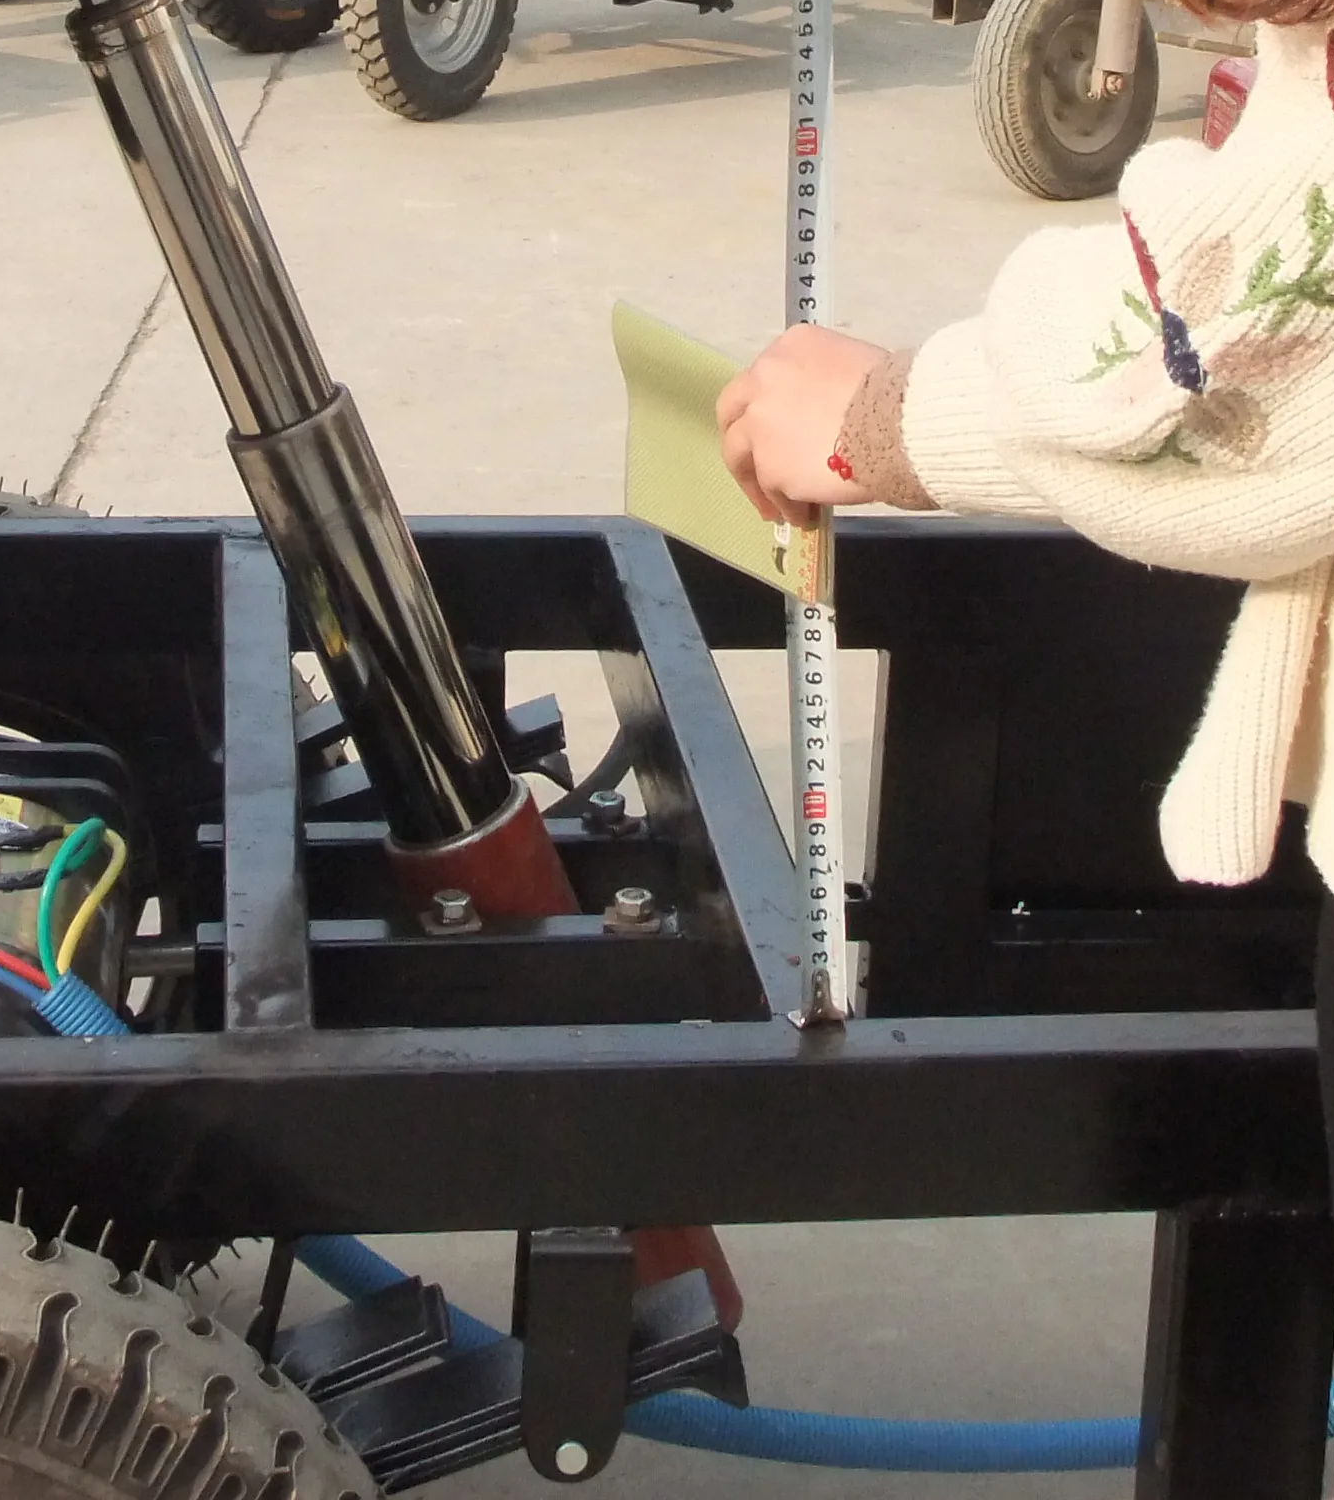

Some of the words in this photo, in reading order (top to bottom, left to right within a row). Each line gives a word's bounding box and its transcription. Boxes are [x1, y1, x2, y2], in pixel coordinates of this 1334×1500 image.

[798, 0, 814, 14] 6
[798, 22, 814, 37] 5
[798, 45, 814, 60] 4
[798, 69, 814, 83] 3
[797, 91, 814, 106] 2
[798, 117, 814, 129] 1
[798, 131, 816, 154] 40
[798, 159, 815, 176] 9
[797, 183, 815, 198] 8
[797, 207, 816, 221] 7
[797, 227, 816, 243] 6
[797, 250, 816, 266] 5
[797, 273, 816, 289] 4
[797, 296, 817, 312] 3
[803, 607, 821, 620] 9
[804, 628, 822, 642] 8
[804, 651, 822, 663] 7
[805, 671, 823, 685] 6
[805, 694, 823, 707] 5
[806, 712, 823, 728] 4
[806, 737, 824, 750] 3
[806, 758, 825, 774] 2
[807, 782, 825, 792] 1
[804, 794, 825, 817] 10
[807, 822, 826, 837] 9
[808, 843, 827, 859] 8
[810, 866, 827, 880] 7
[810, 887, 827, 901] 6
[810, 908, 828, 923] 5
[811, 929, 828, 943] 4
[812, 950, 828, 964] 3
